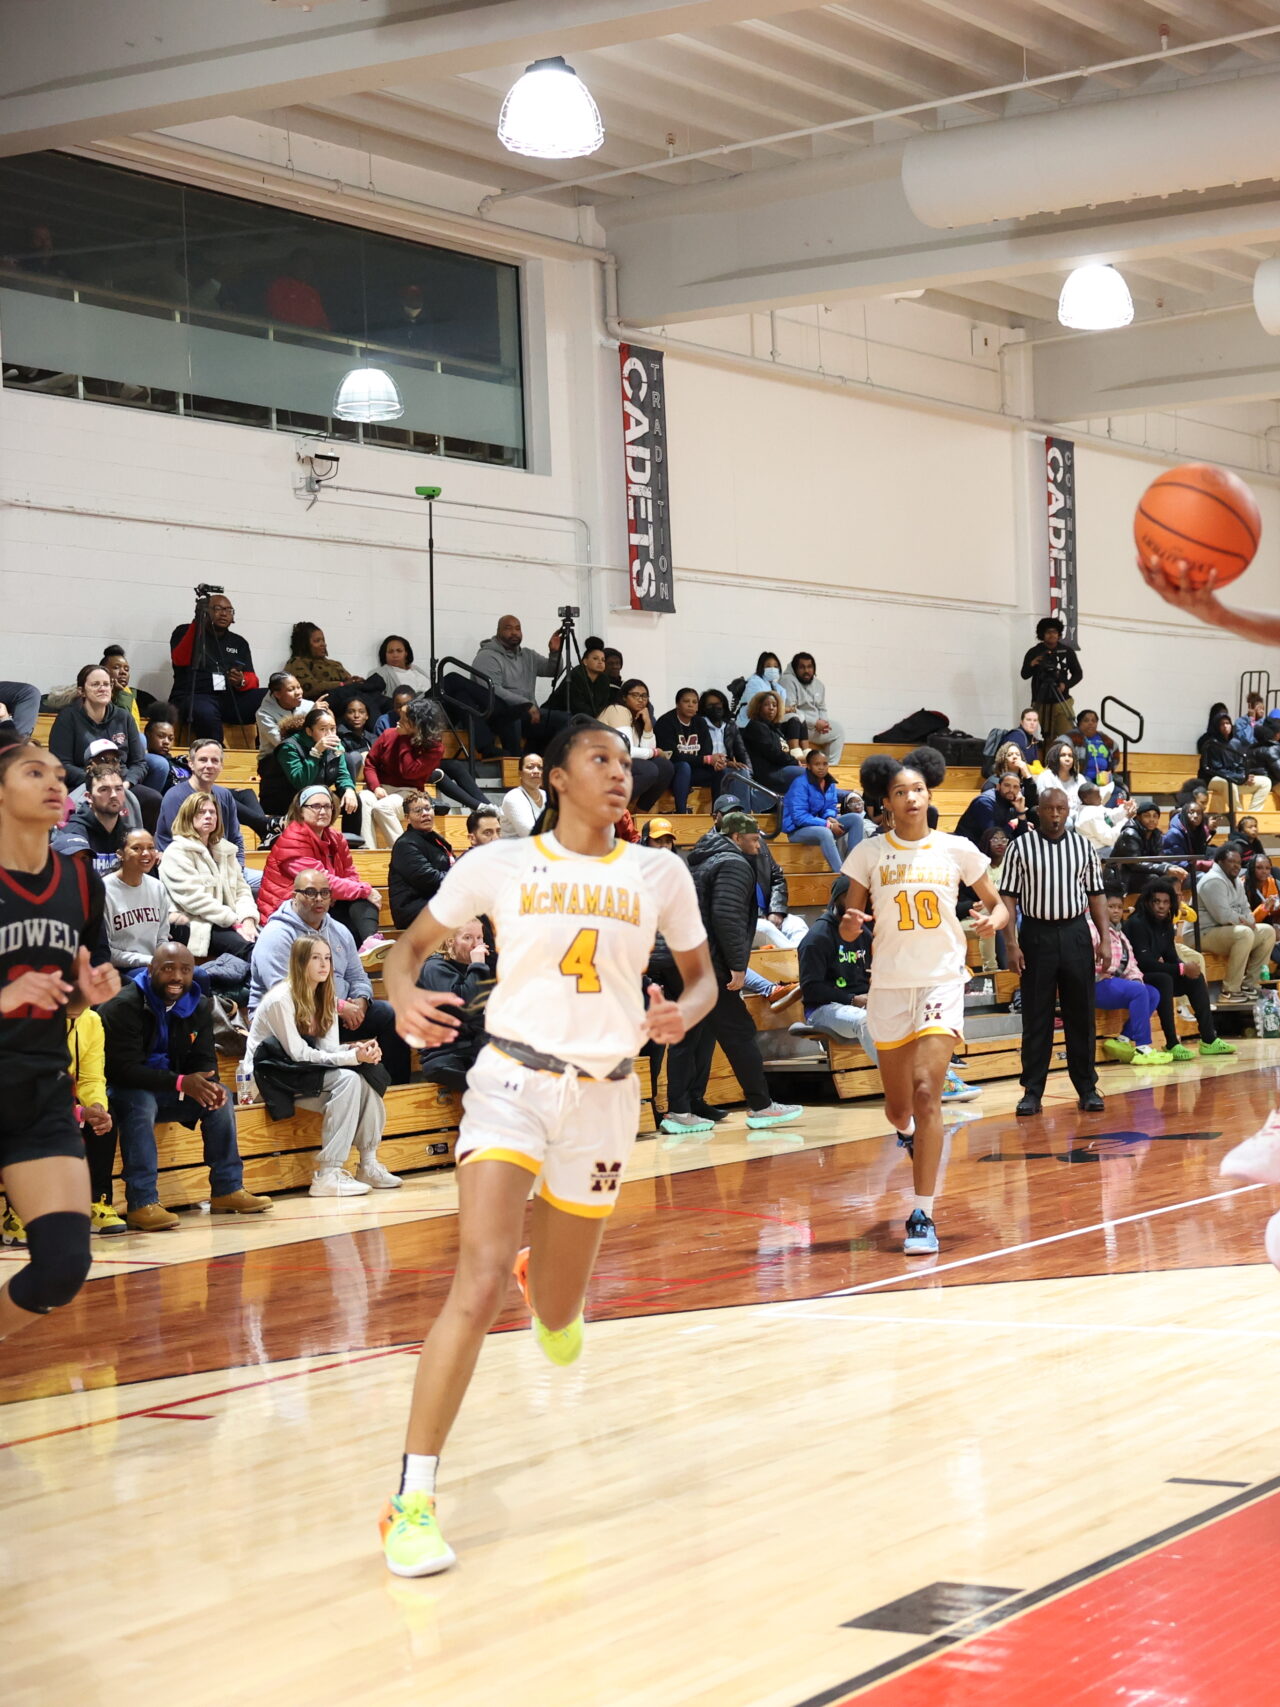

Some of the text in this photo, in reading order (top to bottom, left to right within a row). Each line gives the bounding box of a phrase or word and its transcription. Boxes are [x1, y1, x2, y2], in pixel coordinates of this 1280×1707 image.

[623, 357, 656, 599] CADETS
[651, 363, 670, 600] TRADITION
[113, 907, 160, 931] SIDWEL
[519, 882, 641, 927] McNAMARA
[894, 890, 942, 931] 10
[559, 928, 601, 993] 4
